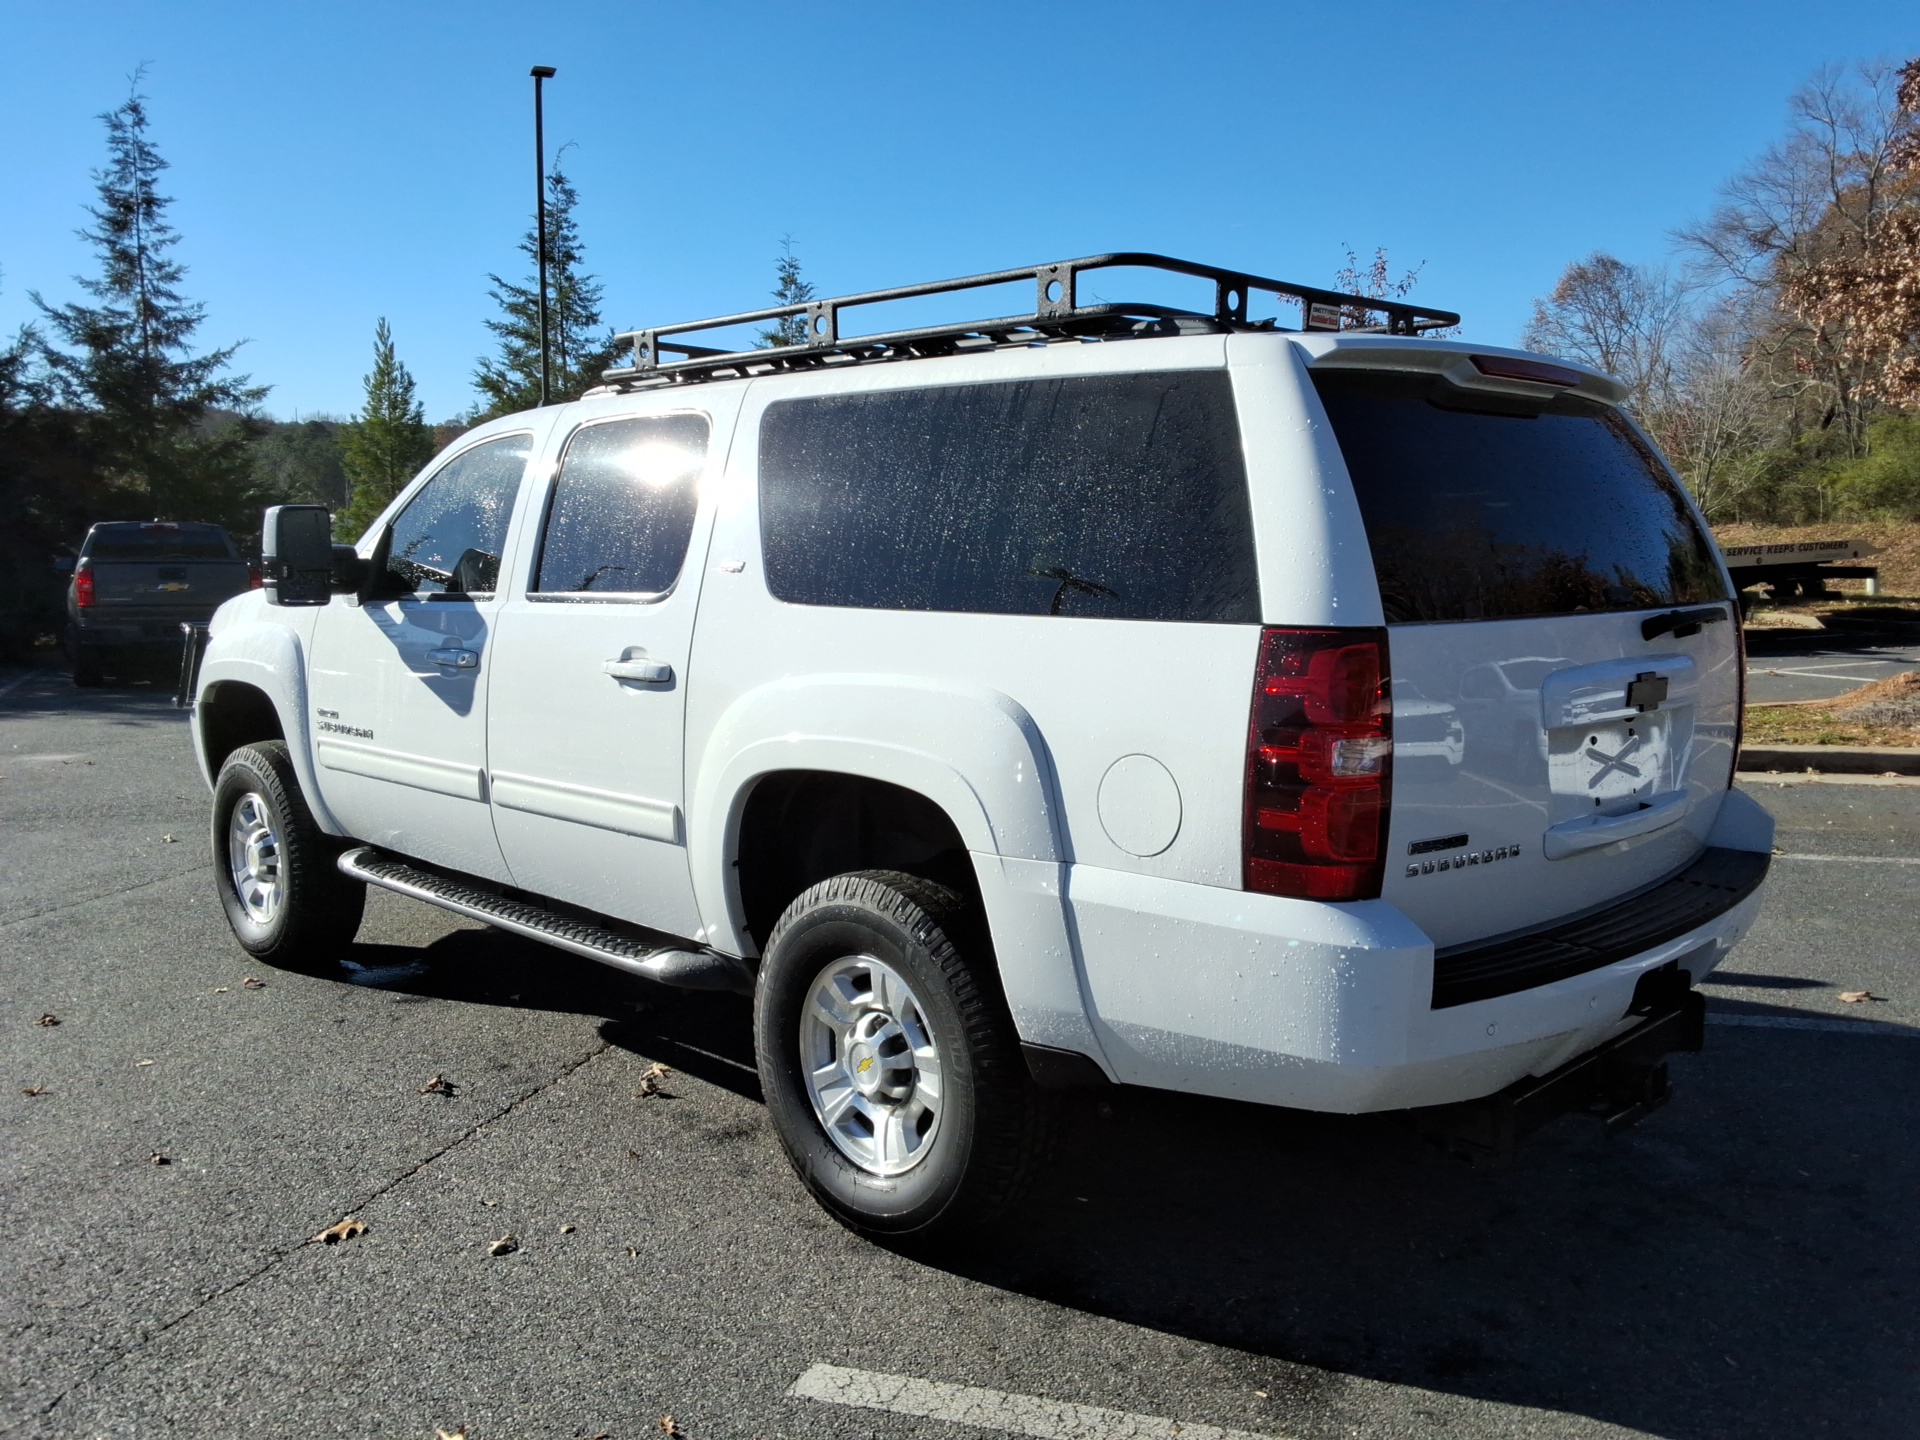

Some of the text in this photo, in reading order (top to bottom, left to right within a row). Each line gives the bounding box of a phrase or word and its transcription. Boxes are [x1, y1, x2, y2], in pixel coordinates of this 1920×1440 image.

[1726, 540, 1849, 557] SERVICE KEEPS CUSTOMERS
[1405, 843, 1521, 878] SUBURBAN
